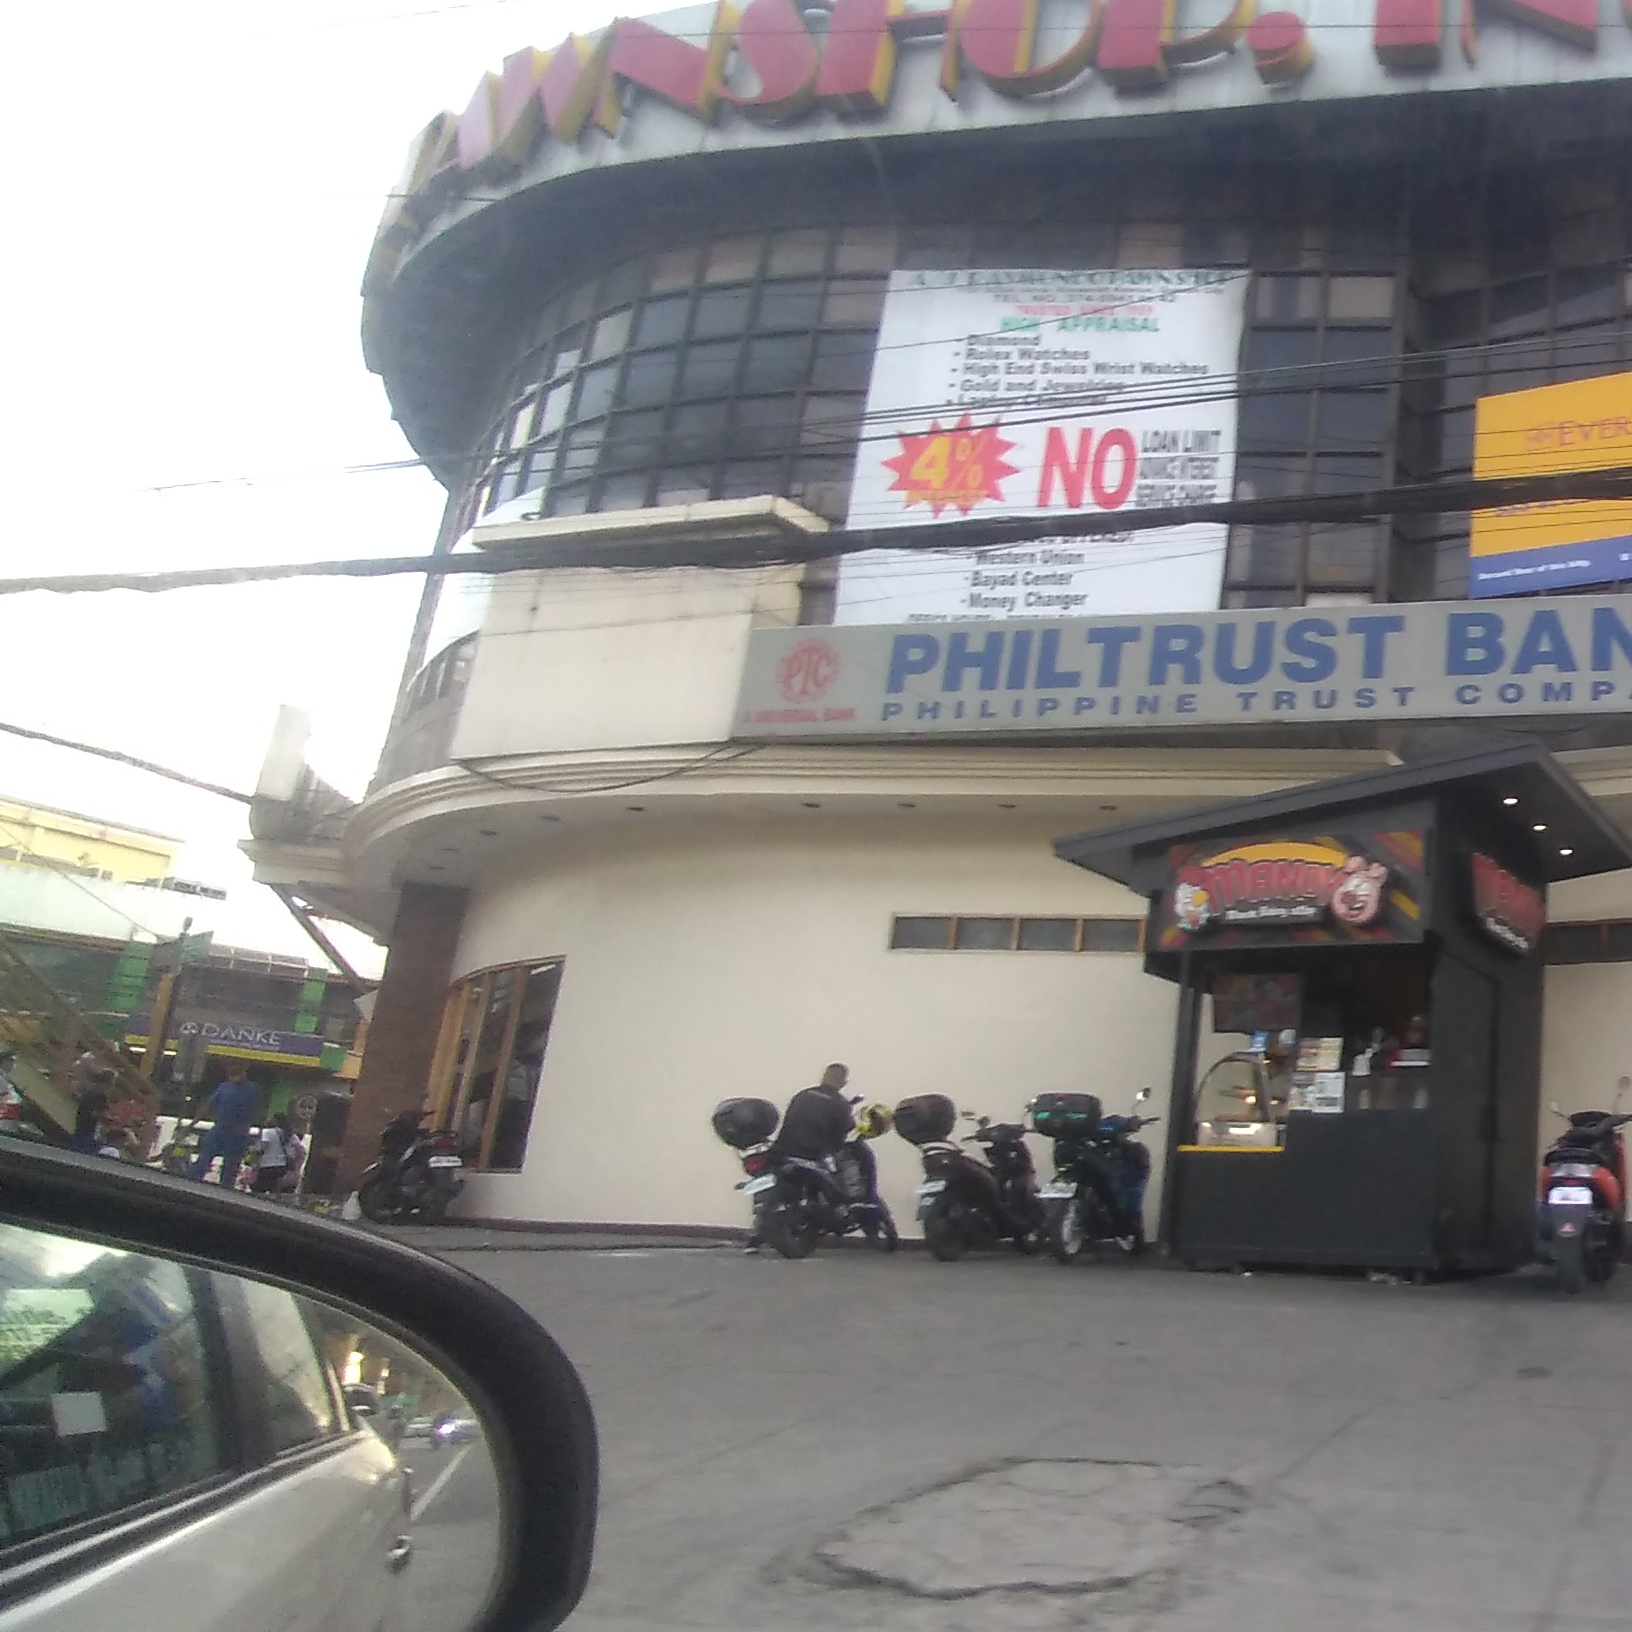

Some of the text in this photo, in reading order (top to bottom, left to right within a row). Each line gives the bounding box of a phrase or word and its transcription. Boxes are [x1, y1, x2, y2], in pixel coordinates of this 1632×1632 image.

[1057, 316, 1160, 332] APPRAISAL
[1017, 347, 1091, 361] Watches
[963, 361, 1001, 378] High
[1004, 361, 1036, 376] End
[1038, 361, 1088, 375] Swiss
[1139, 361, 1209, 375] Watches
[960, 378, 1000, 392] Gold
[1003, 378, 1037, 392] and
[1141, 429, 1179, 453] LOAN
[1036, 426, 1139, 511] NO
[975, 549, 1086, 566] Western Union
[970, 570, 1075, 590] Bayad Center
[967, 590, 1089, 612] Money Changer
[884, 614, 1406, 695] PHILTRUST
[880, 692, 1200, 722] PHILIPPINE
[1239, 687, 1416, 712] TRUST
